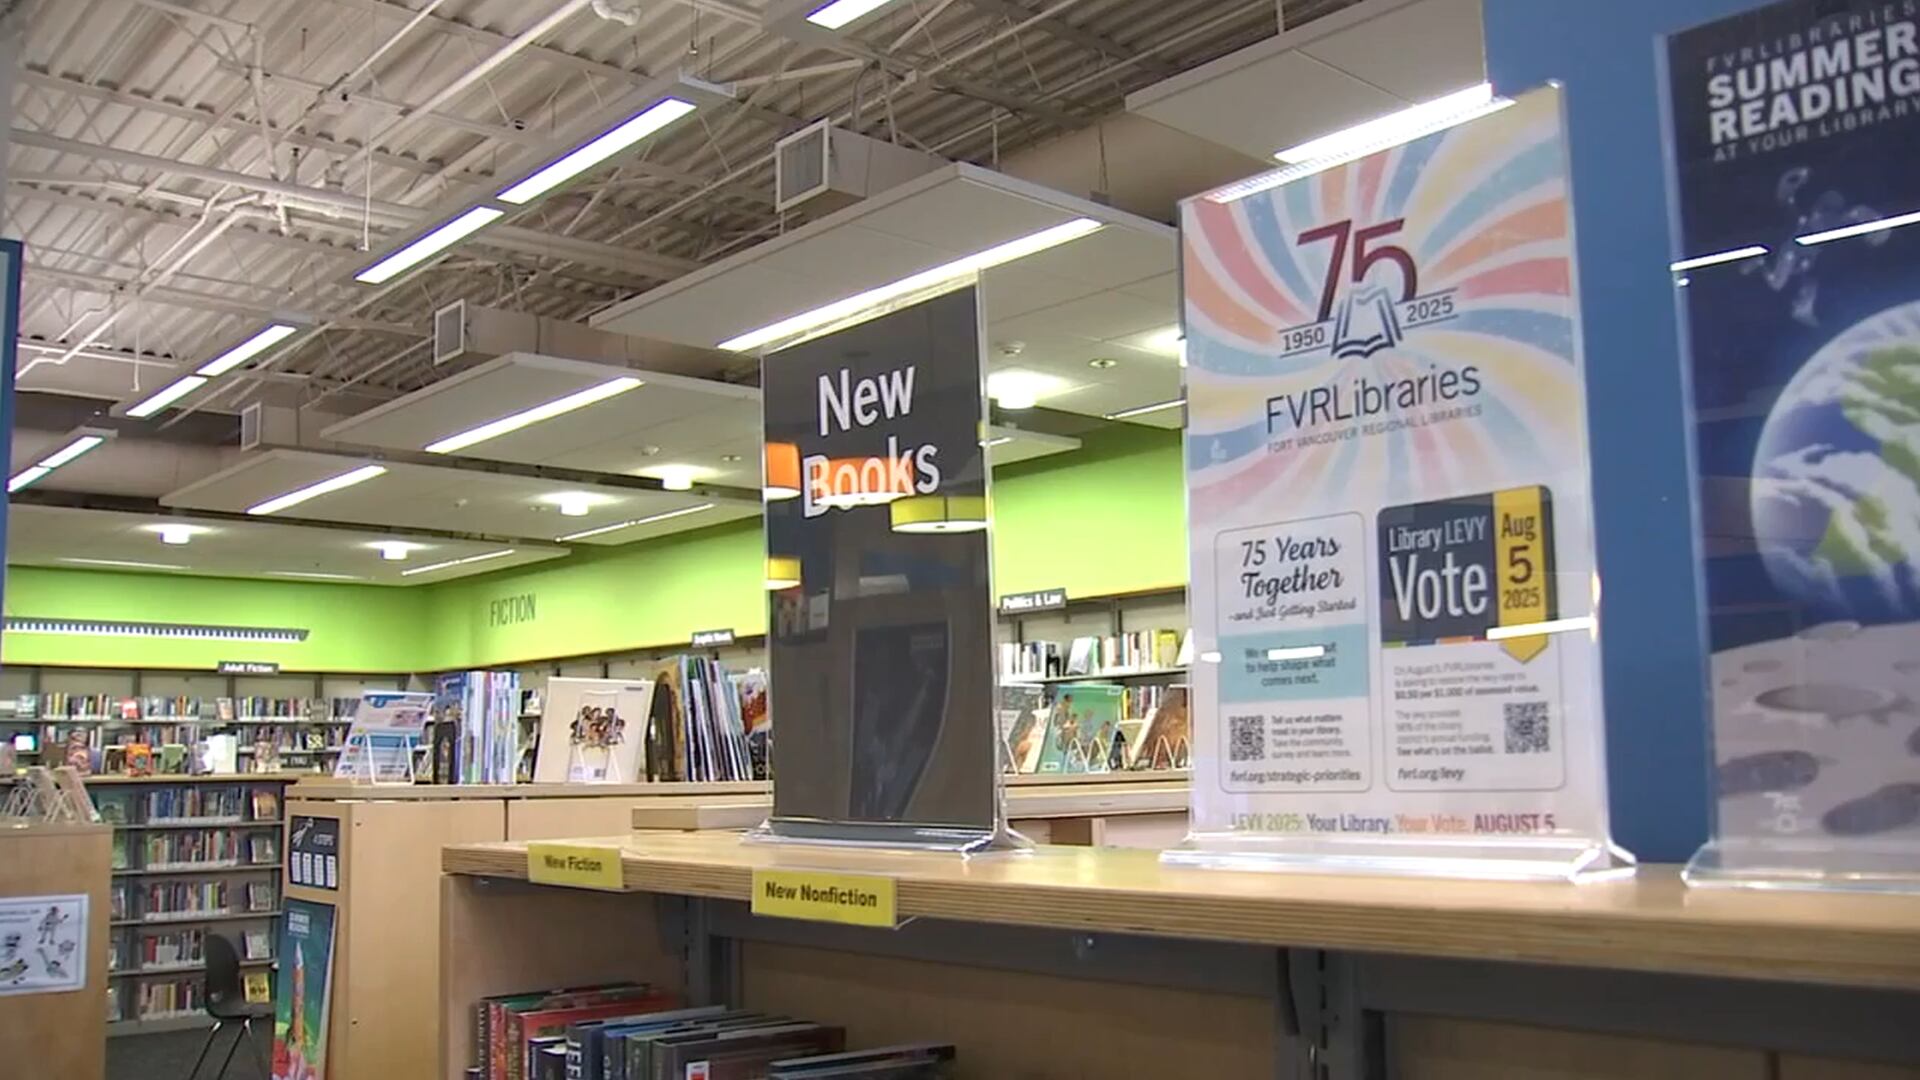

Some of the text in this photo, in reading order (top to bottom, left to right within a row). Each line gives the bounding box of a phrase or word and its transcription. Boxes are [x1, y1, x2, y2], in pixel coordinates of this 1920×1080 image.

[1707, 20, 1920, 110] SUMMER
[1709, 57, 1920, 145] READING
[1714, 144, 1738, 162] AT
[1749, 126, 1809, 153] YOUR
[1297, 217, 1418, 323] 75
[1406, 298, 1454, 324] 2025
[1282, 326, 1325, 352] 1950
[818, 366, 916, 437] New
[1266, 364, 1481, 435] FVRLibraries
[1267, 403, 1482, 455] FORT VANCOUVER REGIONAL LIBRARIES
[802, 435, 942, 518] Books
[1389, 515, 1487, 552] Library LEVY
[1501, 512, 1537, 542] Aug
[1241, 535, 1342, 567] 75 Years
[1508, 544, 1533, 585] 5
[1240, 564, 1344, 606] Together
[1389, 551, 1489, 622] Vote
[1502, 587, 1540, 611] 2025
[490, 594, 536, 627] FICTION
[1306, 813, 1337, 832] Your
[1394, 814, 1428, 832] Your
[1473, 813, 1540, 833] AUGUST
[543, 853, 603, 873] New Fiction
[764, 880, 878, 908] New Nonfiction
